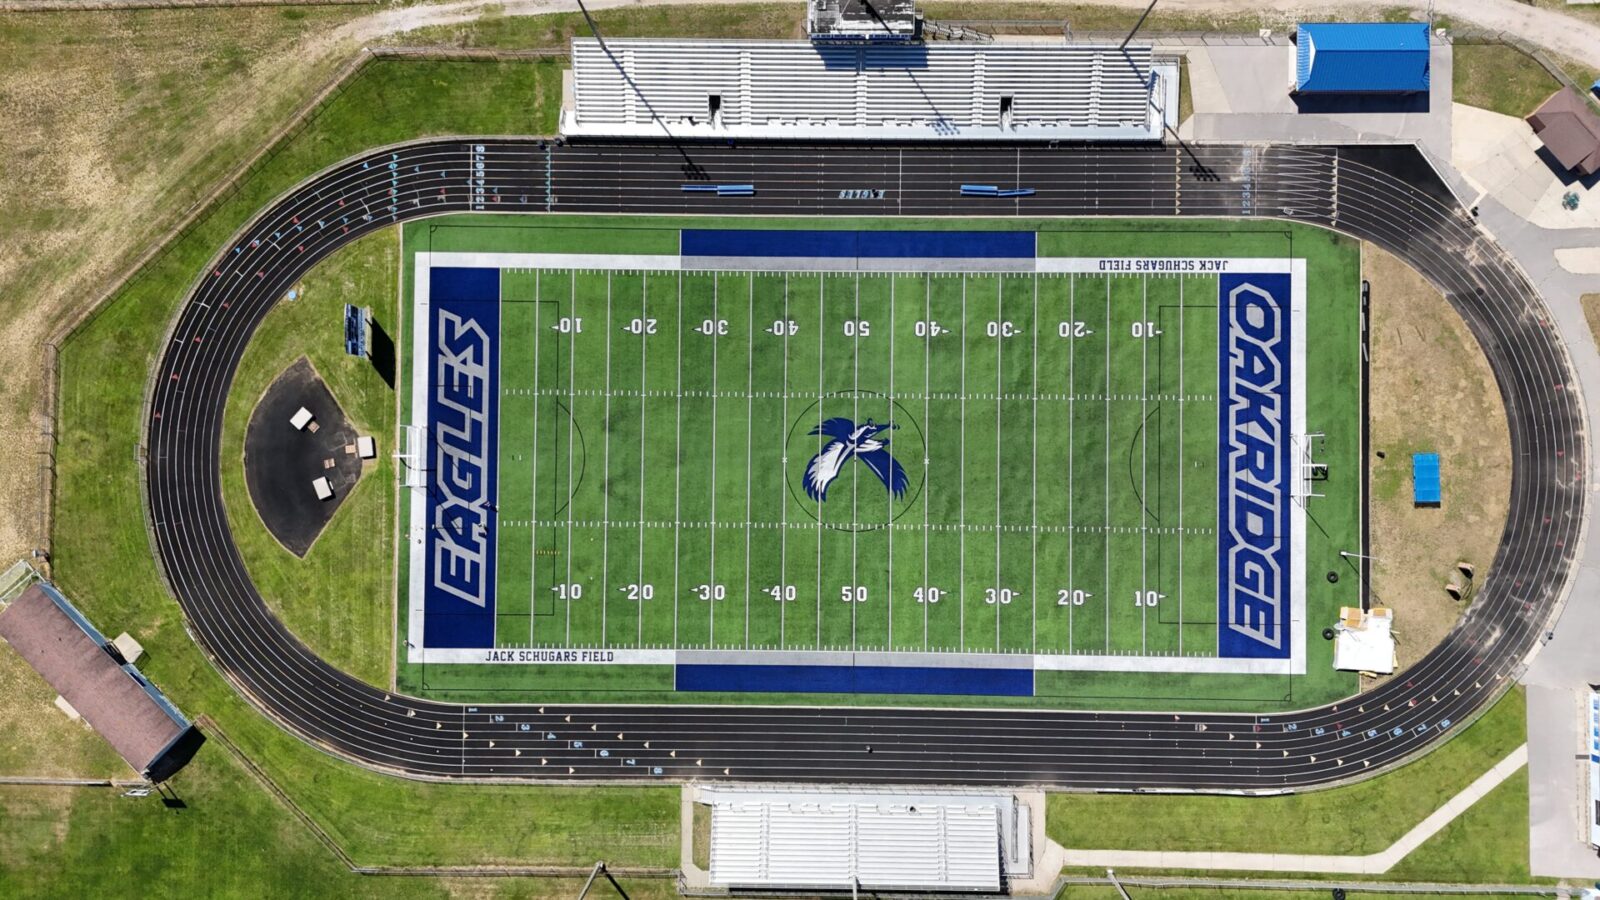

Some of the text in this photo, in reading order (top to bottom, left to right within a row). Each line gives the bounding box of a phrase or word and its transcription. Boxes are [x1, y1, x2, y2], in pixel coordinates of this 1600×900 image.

[475, 179, 485, 187] 4
[1100, 260, 1228, 270] JACK SCHUGARS FIELD
[560, 318, 582, 333] 10
[630, 318, 657, 334] 20
[702, 320, 728, 335] 30
[773, 320, 799, 336] 40
[844, 321, 870, 337] 50
[915, 321, 940, 337] 40
[986, 321, 1013, 337] 30
[1058, 321, 1085, 337] 20
[1132, 322, 1154, 337] 10
[434, 308, 490, 608] EAGLES
[1228, 282, 1281, 650] OAKRIDGE
[559, 584, 582, 599] 10
[627, 584, 654, 600] 20
[699, 584, 725, 600] 30
[770, 585, 796, 601] 40
[842, 586, 867, 601] 50
[913, 587, 939, 603] 40
[985, 588, 1012, 604] 30
[1058, 590, 1084, 605] 20
[1135, 591, 1158, 607] 10
[485, 651, 614, 662] JACK SCHUGARS FIELD
